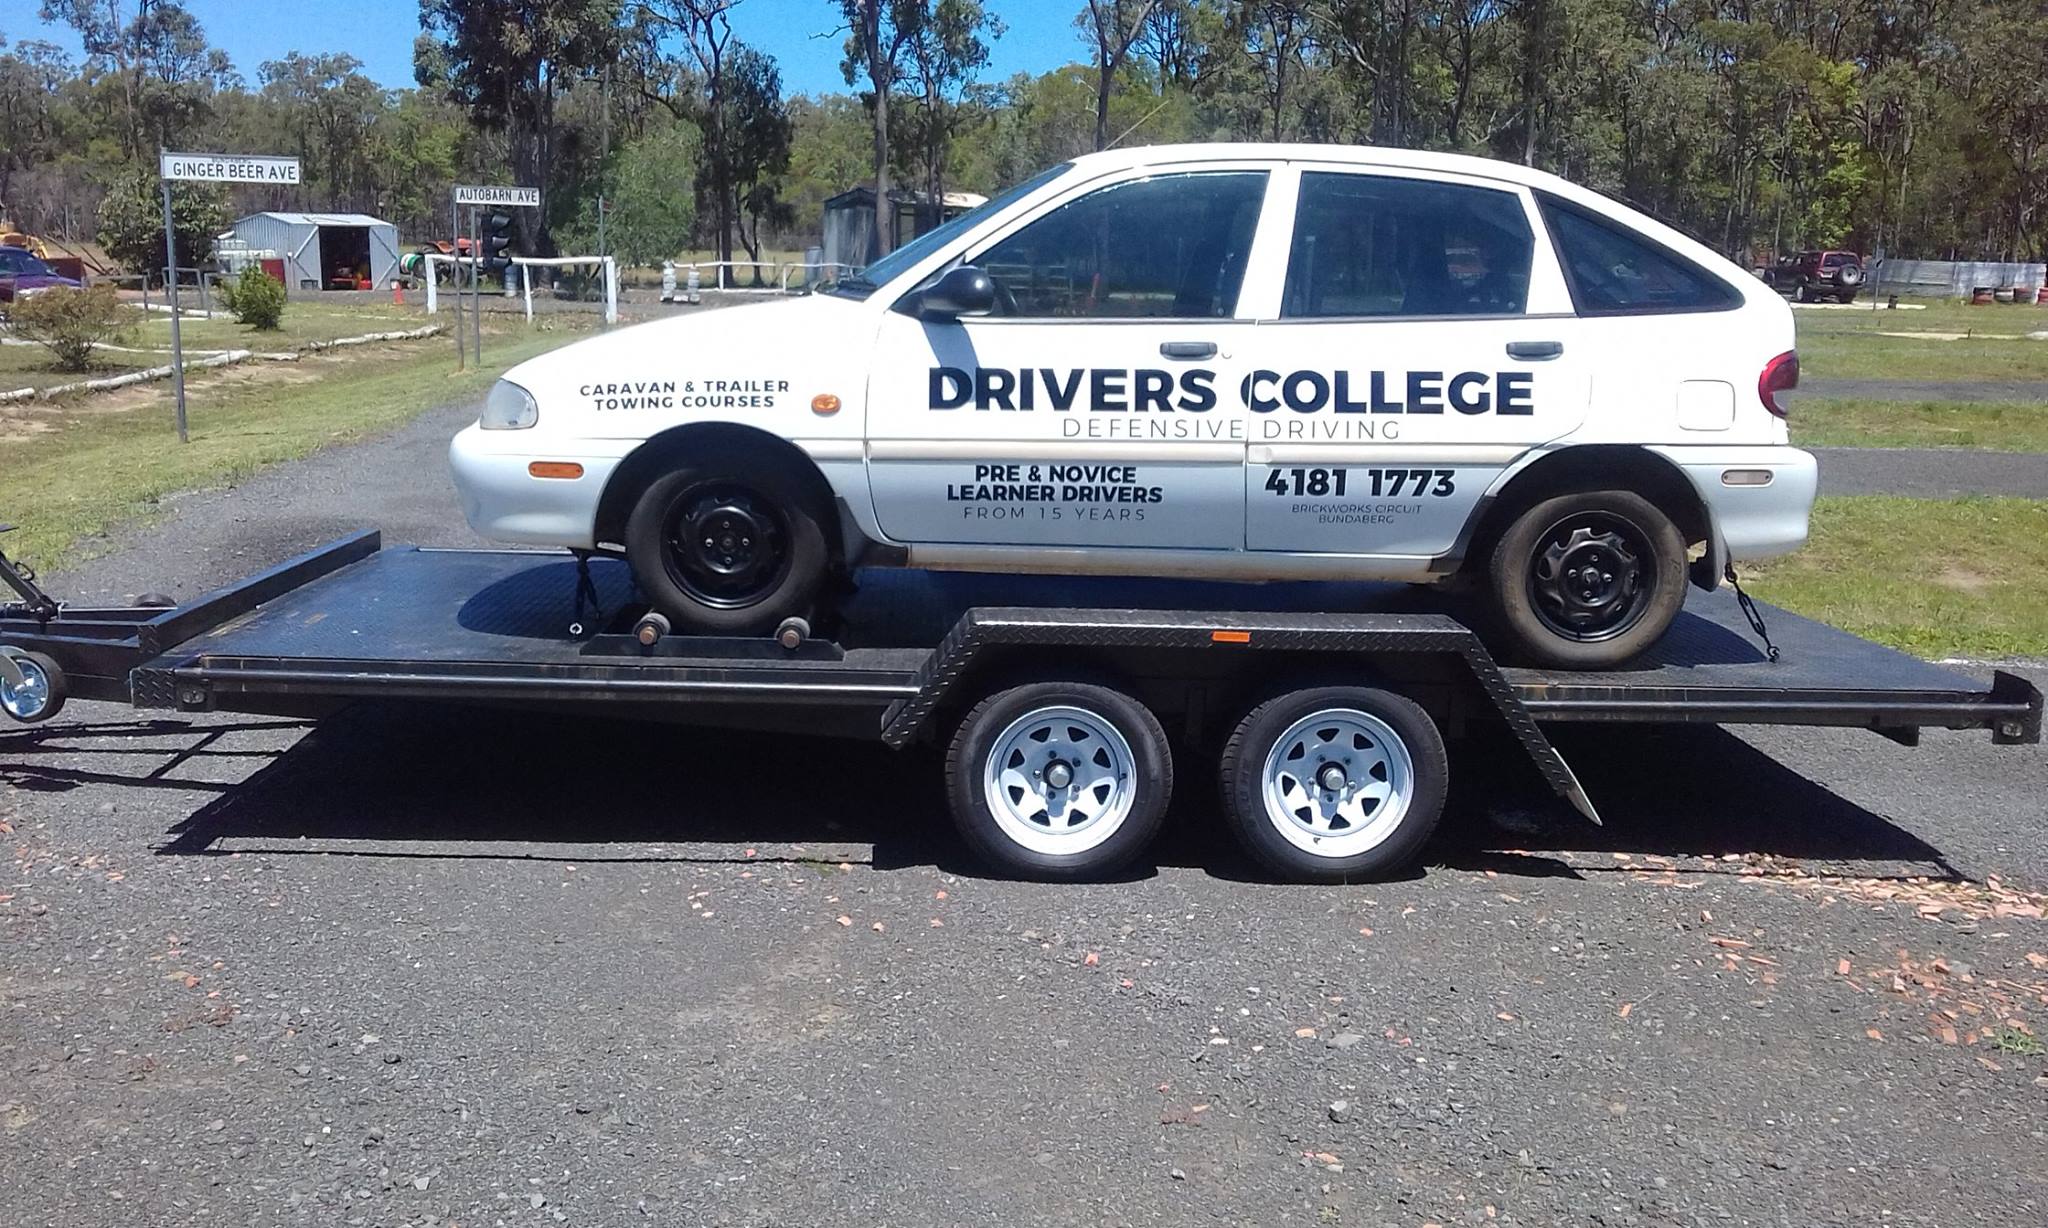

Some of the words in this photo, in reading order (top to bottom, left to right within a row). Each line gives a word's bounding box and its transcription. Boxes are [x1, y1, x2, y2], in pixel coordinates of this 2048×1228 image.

[173, 162, 224, 177] GINGER
[229, 164, 264, 178] BEER
[268, 165, 296, 180] AVE
[459, 188, 512, 201] AUTOBARN
[517, 189, 537, 202] AVE
[580, 381, 676, 396] CARAVAN
[685, 381, 695, 392] &
[703, 380, 790, 393] TRAILER
[928, 367, 1218, 413] DRIVERS
[1240, 369, 1534, 416] COLLEGE
[594, 396, 674, 411] TOWING
[682, 395, 774, 408] COURSES
[1063, 418, 1243, 438] DEFENSIVE
[1263, 419, 1400, 440] DRIVING
[975, 465, 1020, 482] PRE
[1028, 466, 1041, 482] &
[1049, 465, 1137, 484] NOVICE
[1264, 469, 1347, 496] 4181
[1367, 469, 1456, 498] 1773
[947, 484, 1056, 502] LEARNER
[1062, 485, 1163, 503] DRIVERS
[964, 506, 1025, 519] FROM
[1039, 507, 1062, 520] 15
[1075, 507, 1145, 521] YEARS
[1292, 504, 1372, 514] BRICKWORKS
[1375, 504, 1423, 514] CIRCUIT
[1318, 515, 1394, 525] BUNDABERG
